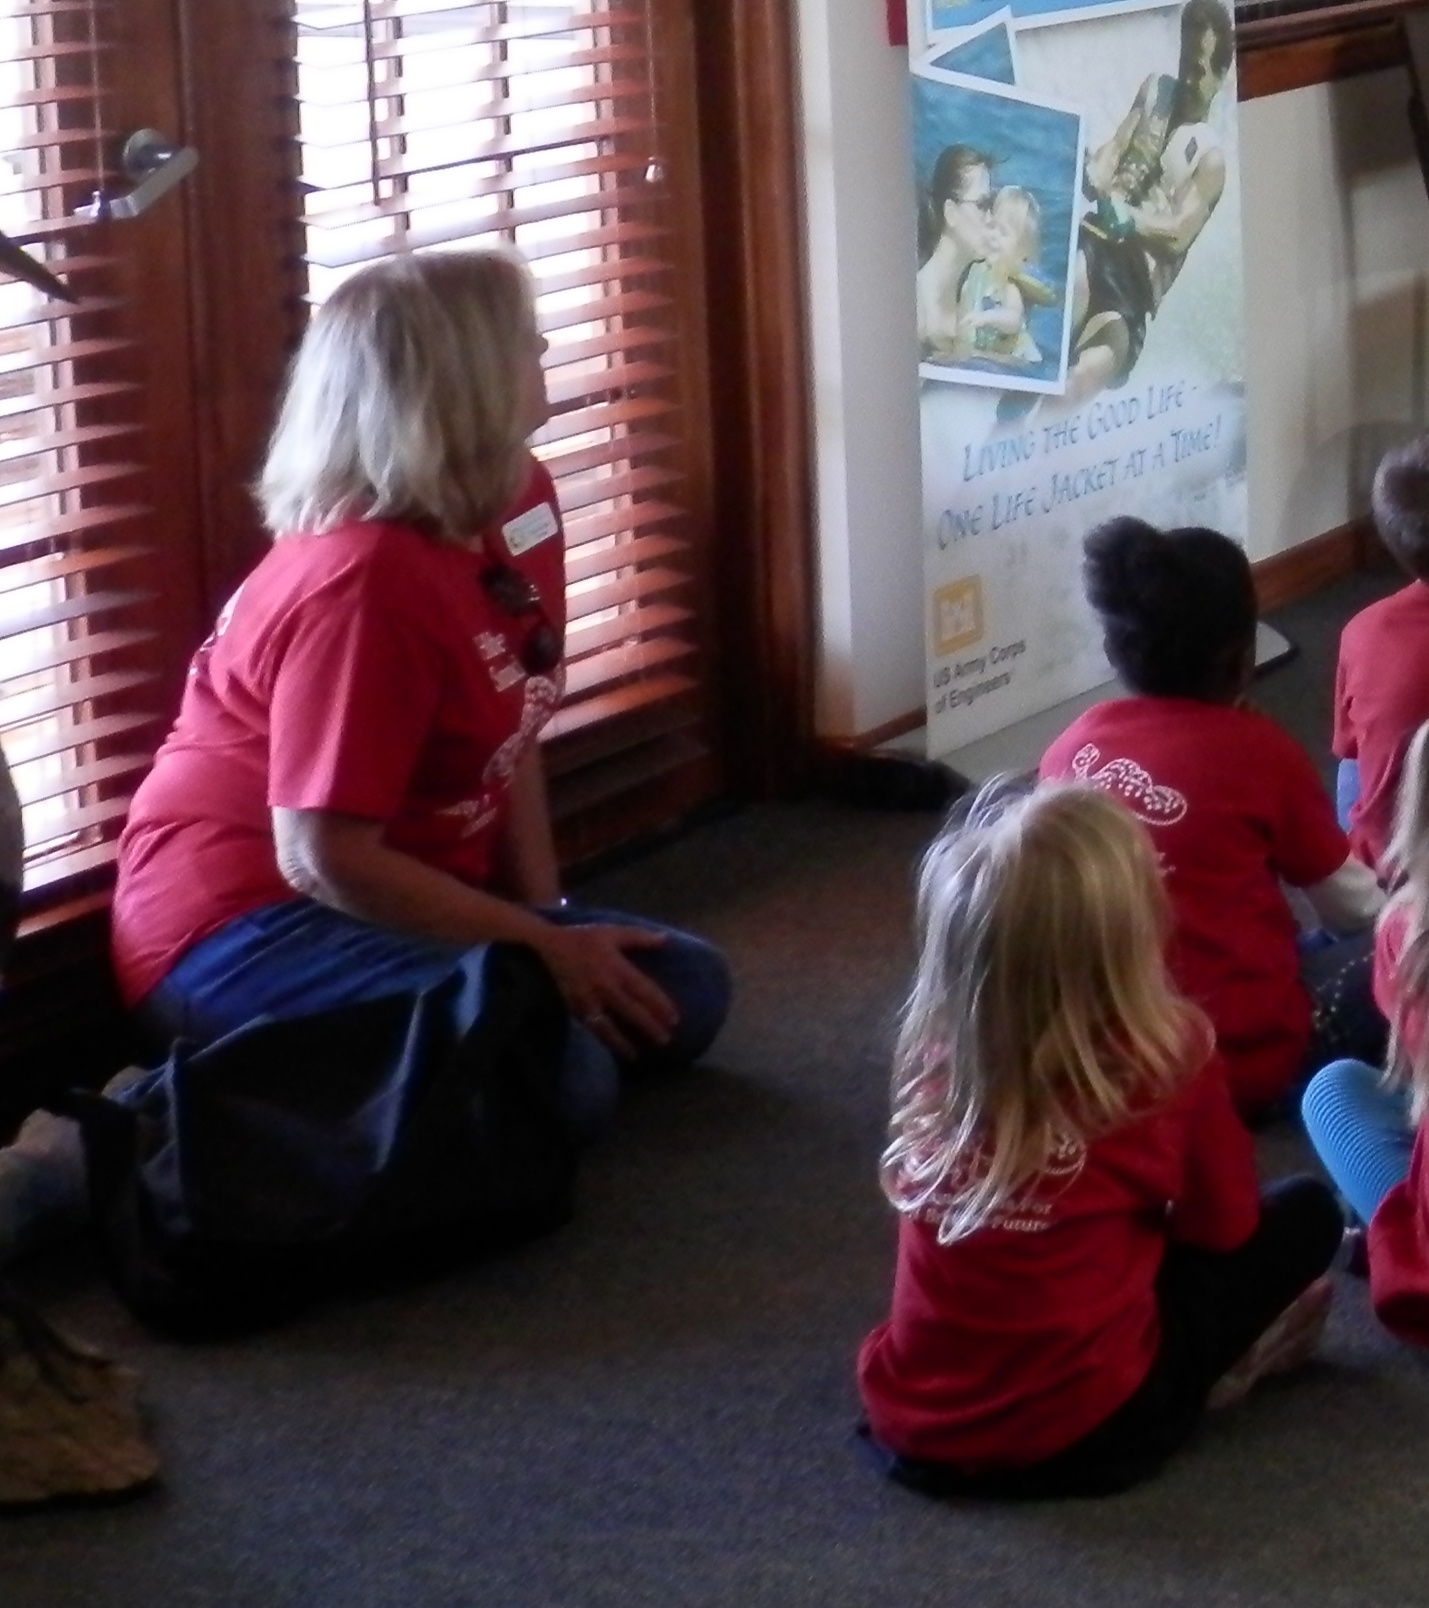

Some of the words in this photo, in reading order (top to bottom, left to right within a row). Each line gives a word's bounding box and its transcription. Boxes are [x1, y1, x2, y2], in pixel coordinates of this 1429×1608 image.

[936, 503, 984, 550] ONE
[991, 486, 1038, 530] LIFE
[1040, 458, 1119, 514] JACKET
[1120, 447, 1147, 480] AT
[1150, 442, 1167, 470] A
[1170, 413, 1222, 463] TIME!
[963, 431, 1036, 482] LIVING
[1042, 415, 1081, 453] THE
[1087, 396, 1140, 441] GOOD
[1147, 381, 1187, 419] LIFE
